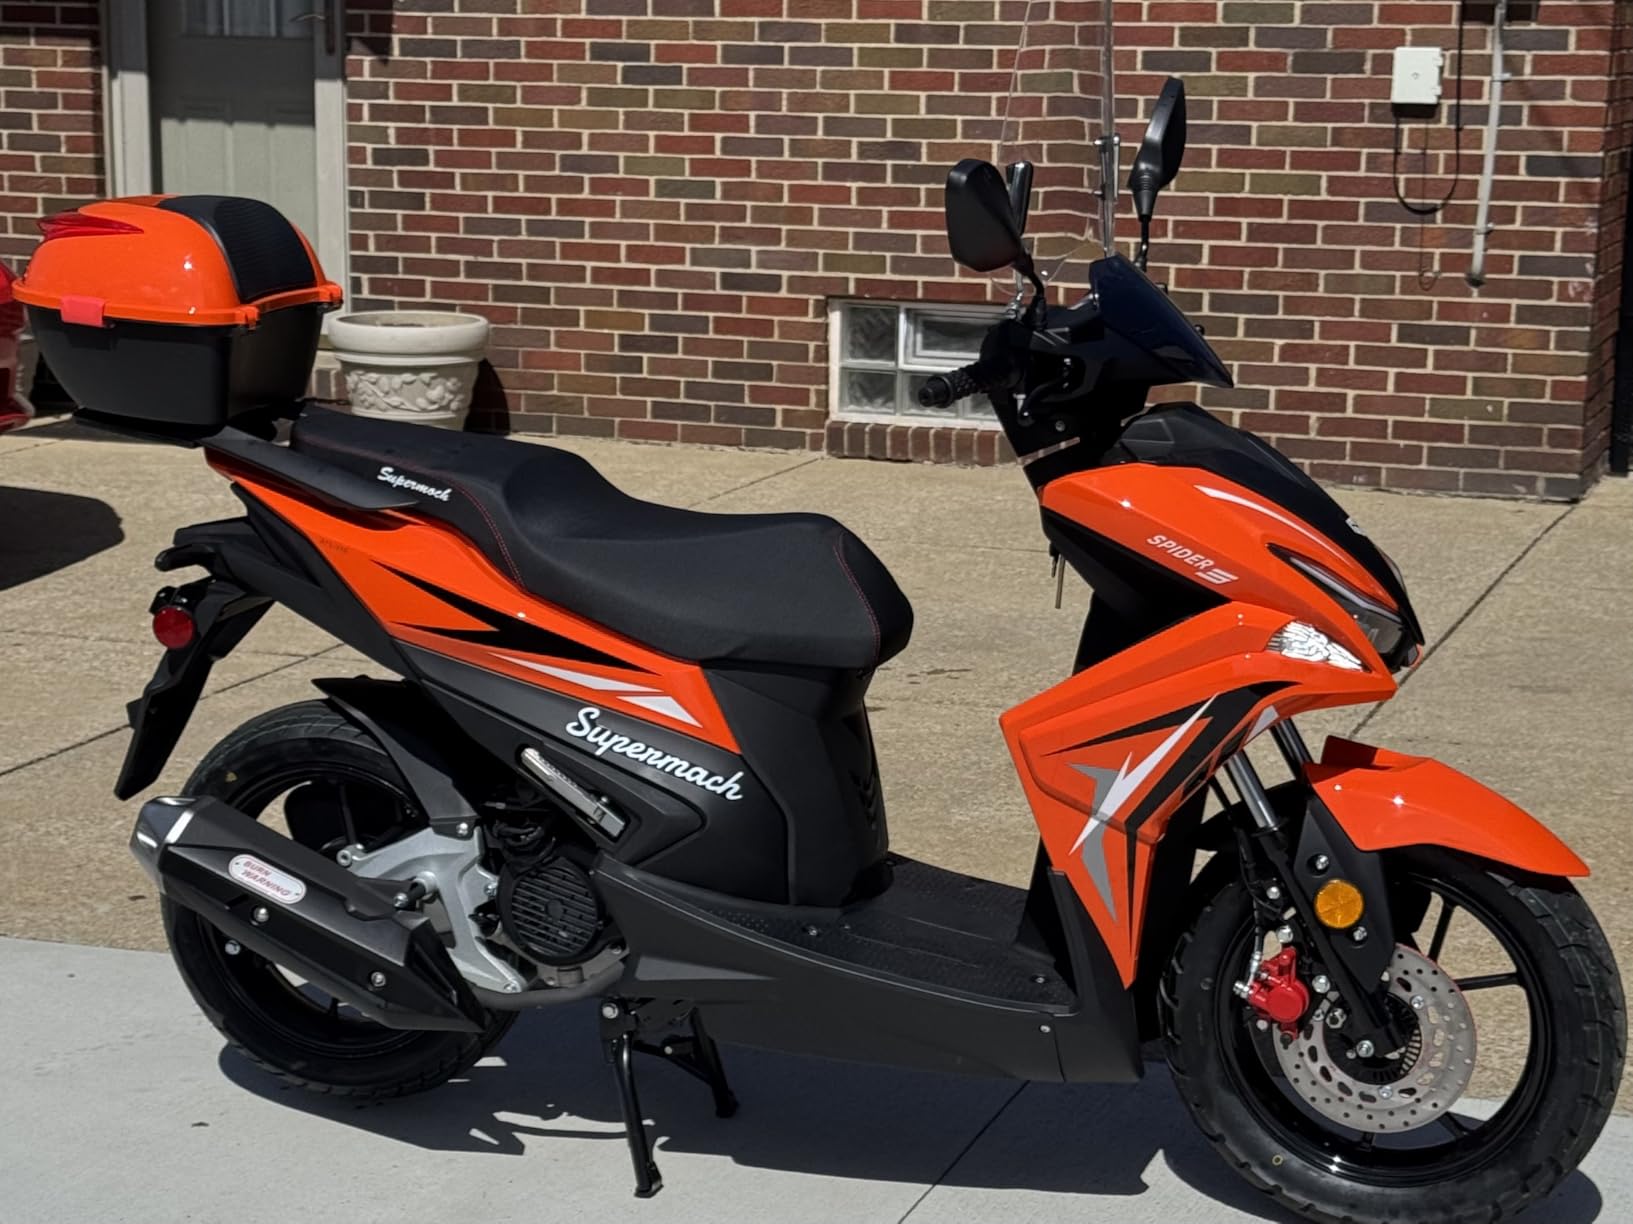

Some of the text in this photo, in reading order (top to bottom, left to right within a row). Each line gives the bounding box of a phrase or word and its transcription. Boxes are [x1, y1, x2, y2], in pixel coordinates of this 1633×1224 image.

[1146, 535, 1215, 569] SPIDER
[565, 707, 744, 800] Supermach
[242, 870, 292, 896] WARNING
[243, 861, 272, 876] BURN
